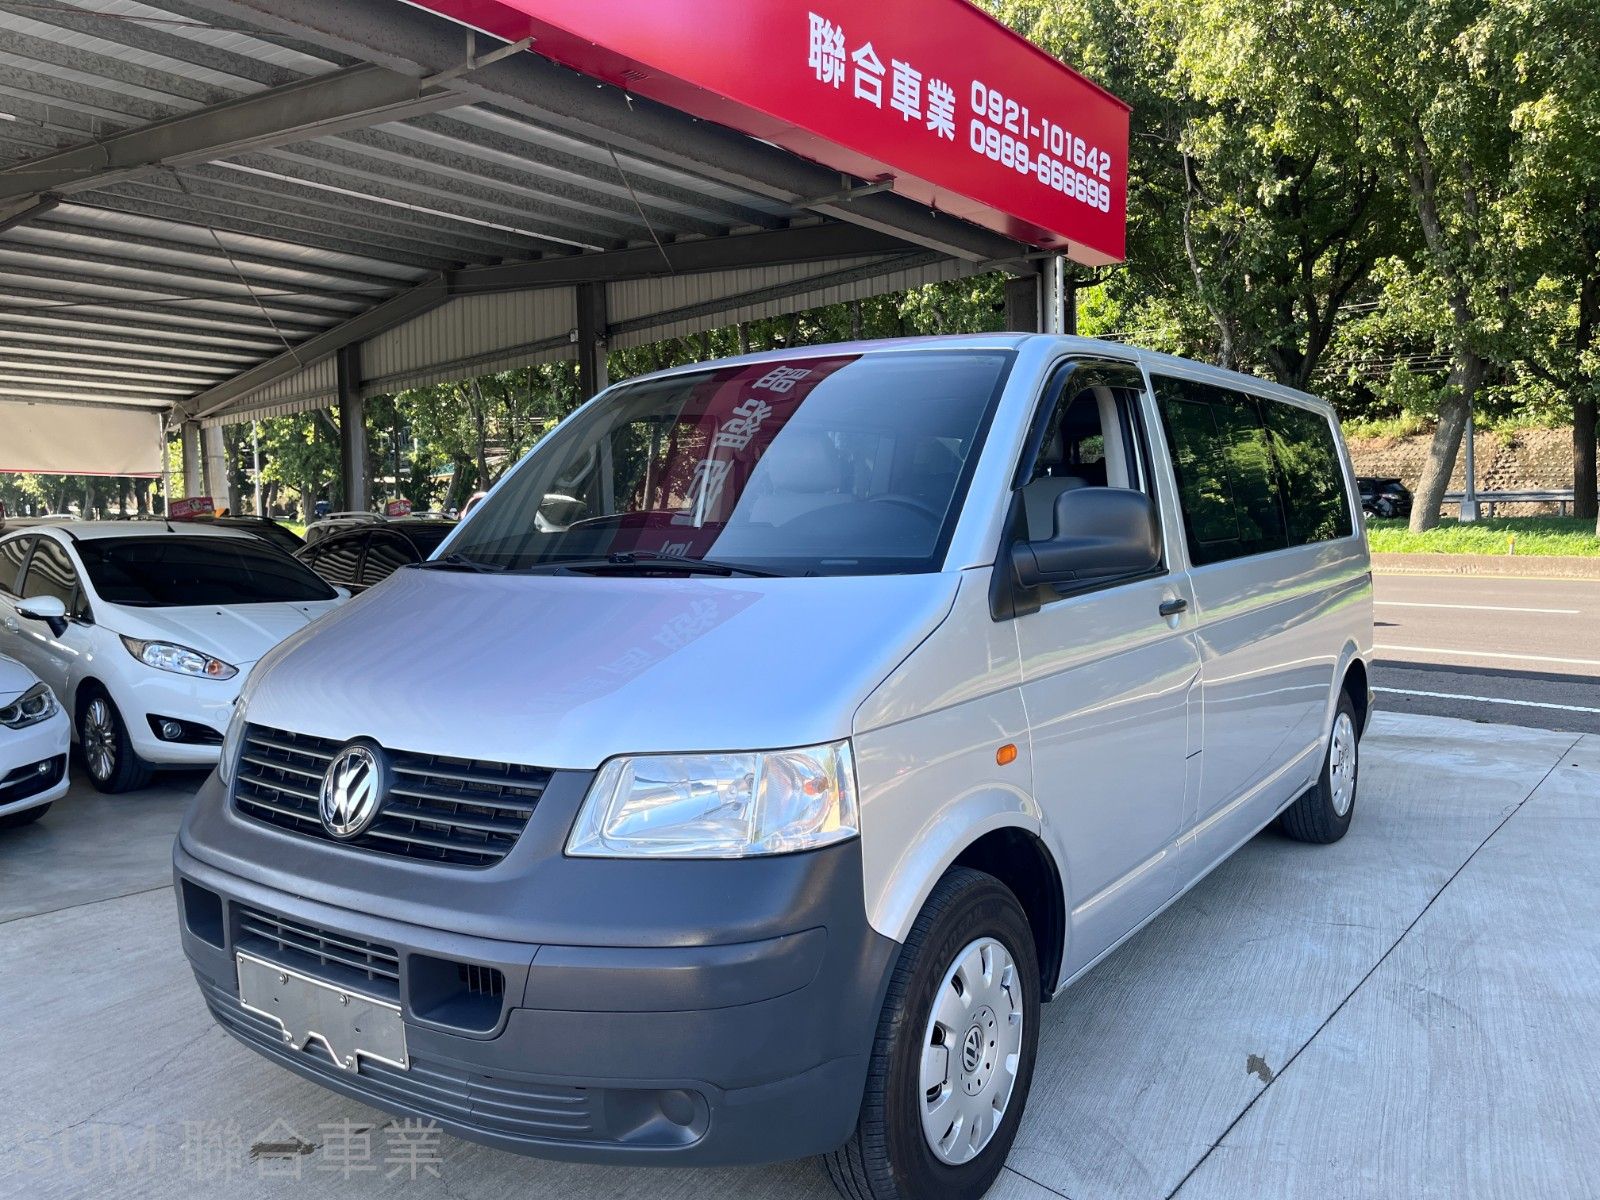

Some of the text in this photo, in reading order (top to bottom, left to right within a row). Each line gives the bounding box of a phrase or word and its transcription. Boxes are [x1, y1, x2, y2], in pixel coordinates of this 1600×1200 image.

[808, 11, 956, 142] 聯合車業
[970, 119, 1110, 213] 0989-666699
[971, 80, 1111, 182] 0921-101642
